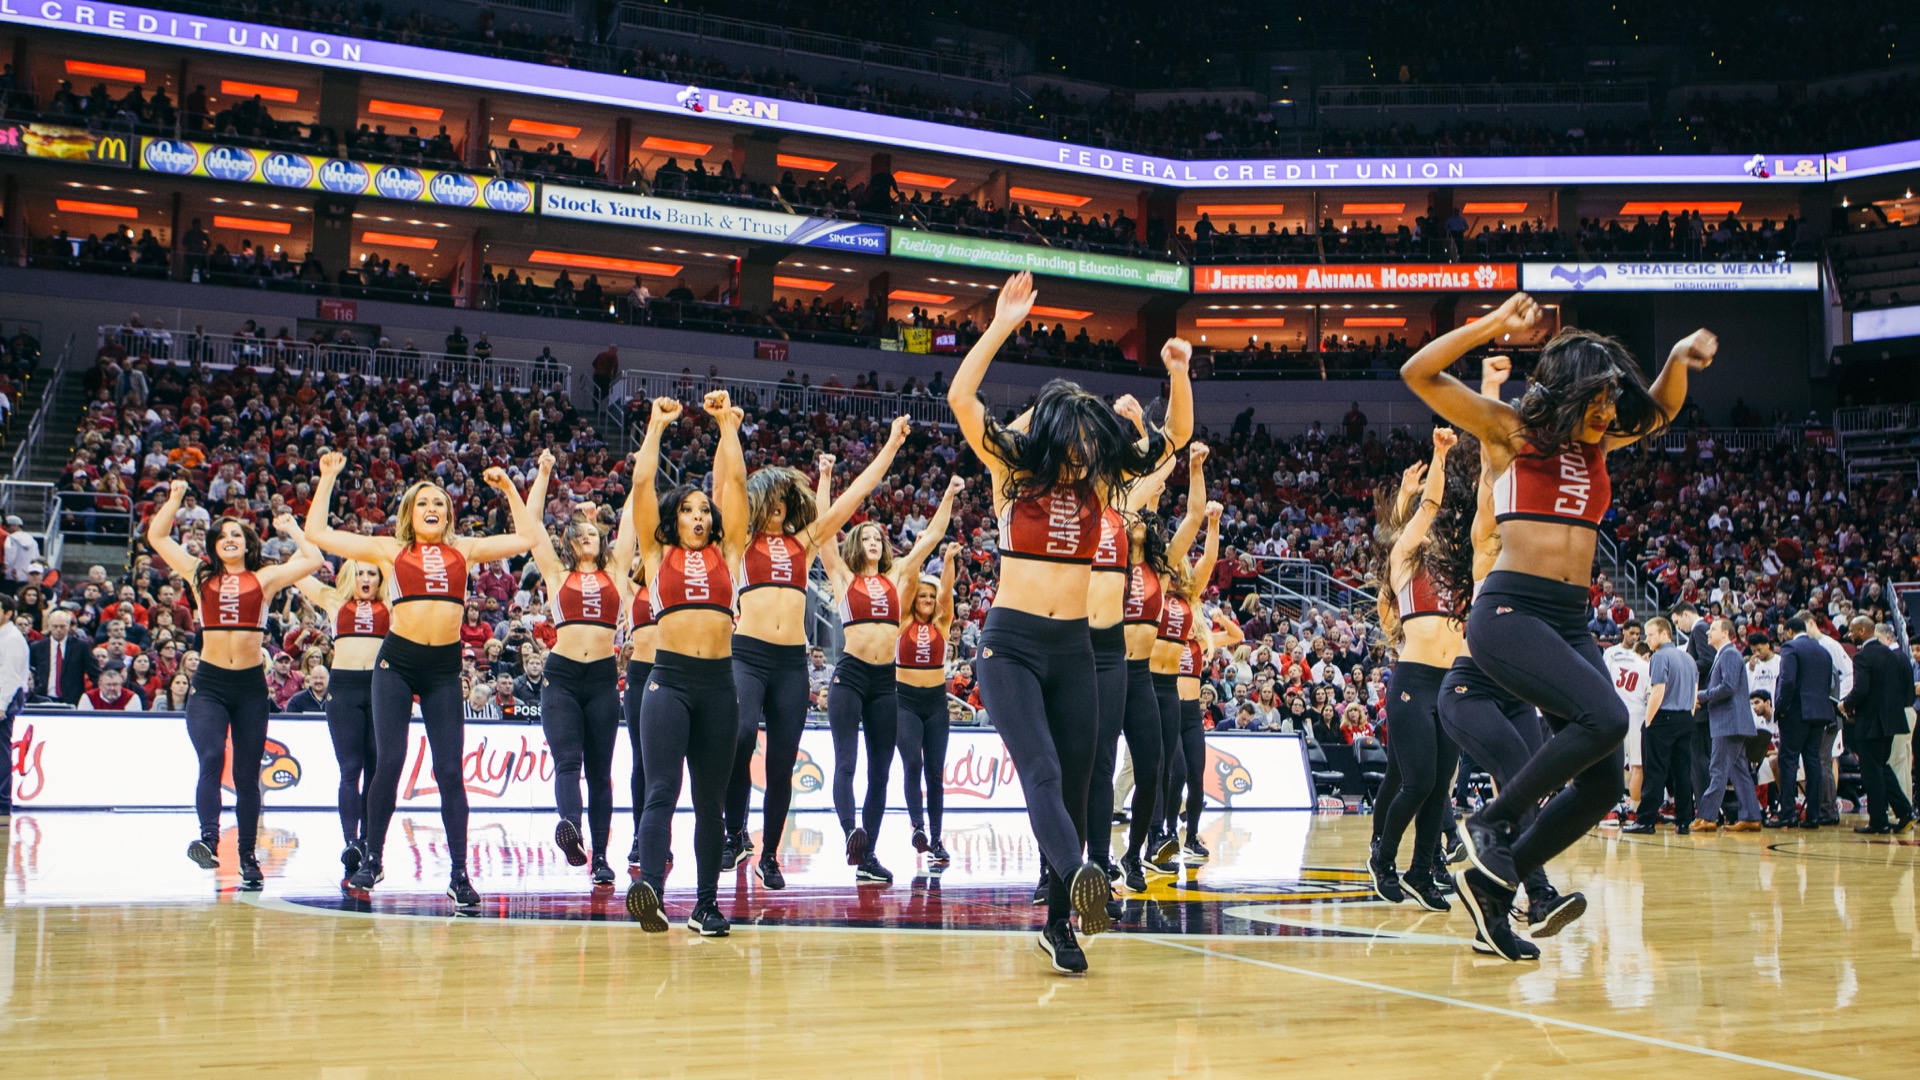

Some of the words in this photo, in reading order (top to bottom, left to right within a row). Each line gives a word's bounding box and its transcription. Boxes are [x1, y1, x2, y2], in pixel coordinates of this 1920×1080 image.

[40, 1, 208, 40] CREDIT
[228, 27, 361, 62] UNION
[708, 94, 779, 120] L&N
[1058, 148, 1198, 181] FEDERAL
[1213, 164, 1339, 180] CREDIT
[1356, 163, 1463, 180] UNION
[1774, 155, 1847, 176] L&N
[548, 194, 604, 214] Stock
[608, 201, 662, 221] Yards
[667, 209, 714, 228] Bank
[719, 215, 733, 230] &
[739, 217, 790, 237] Trust
[828, 233, 857, 246] SINCE
[857, 237, 881, 248] 1904
[897, 237, 947, 258] Fueling
[1026, 253, 1077, 275] Funding
[1079, 260, 1142, 280] Education.
[1616, 263, 1717, 276] STRATEGIC
[1721, 262, 1792, 276] WEALTH
[1210, 269, 1298, 290] JEFFERSON
[1305, 268, 1375, 290] ANIMAL
[1381, 267, 1471, 289] HOSPITALS
[1674, 282, 1739, 291] DESIGNERS
[334, 309, 354, 321] 116
[769, 349, 786, 361] 117
[421, 545, 449, 593] CARDS
[766, 535, 793, 583] CARDS
[218, 574, 241, 626] CARDS
[580, 573, 602, 619] CARDS
[915, 624, 931, 664] CARDS
[1616, 666, 1639, 692] 30
